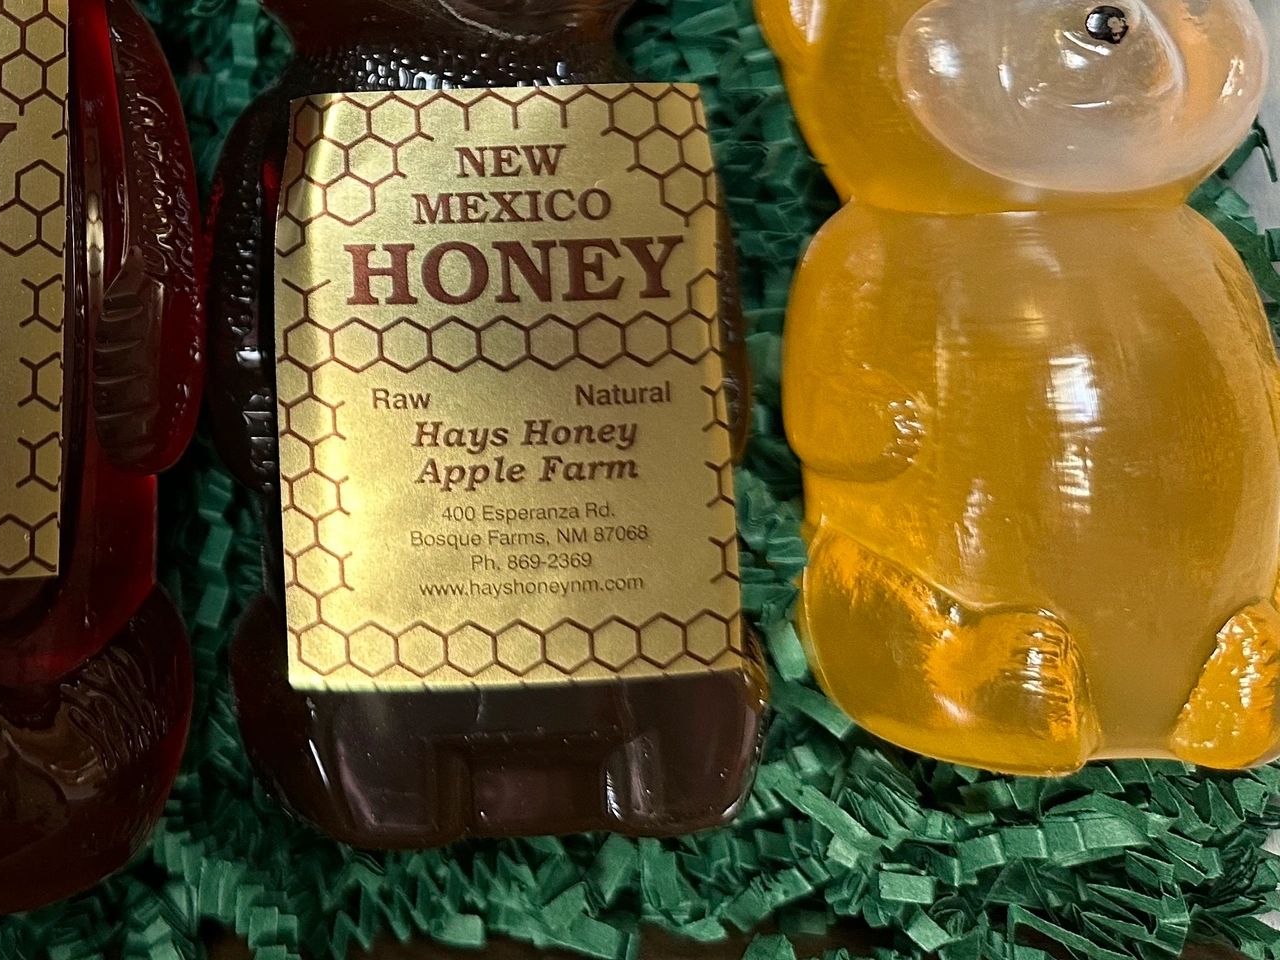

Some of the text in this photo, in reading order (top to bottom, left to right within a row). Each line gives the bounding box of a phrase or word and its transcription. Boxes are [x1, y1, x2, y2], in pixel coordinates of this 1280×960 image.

[456, 144, 567, 178] NEW
[412, 188, 612, 224] MEXICO
[344, 235, 684, 306] HONEY
[372, 381, 671, 410] Raw Natural
[412, 418, 638, 454] Hays Honey
[415, 456, 638, 492] Apple Farm
[442, 502, 615, 526] 400 Esperanza Rd.
[410, 524, 648, 550] Bosque Farms, NM 87068
[471, 552, 592, 570] Ph. 869-2369
[419, 575, 644, 598] www.hayshoneynm.com
